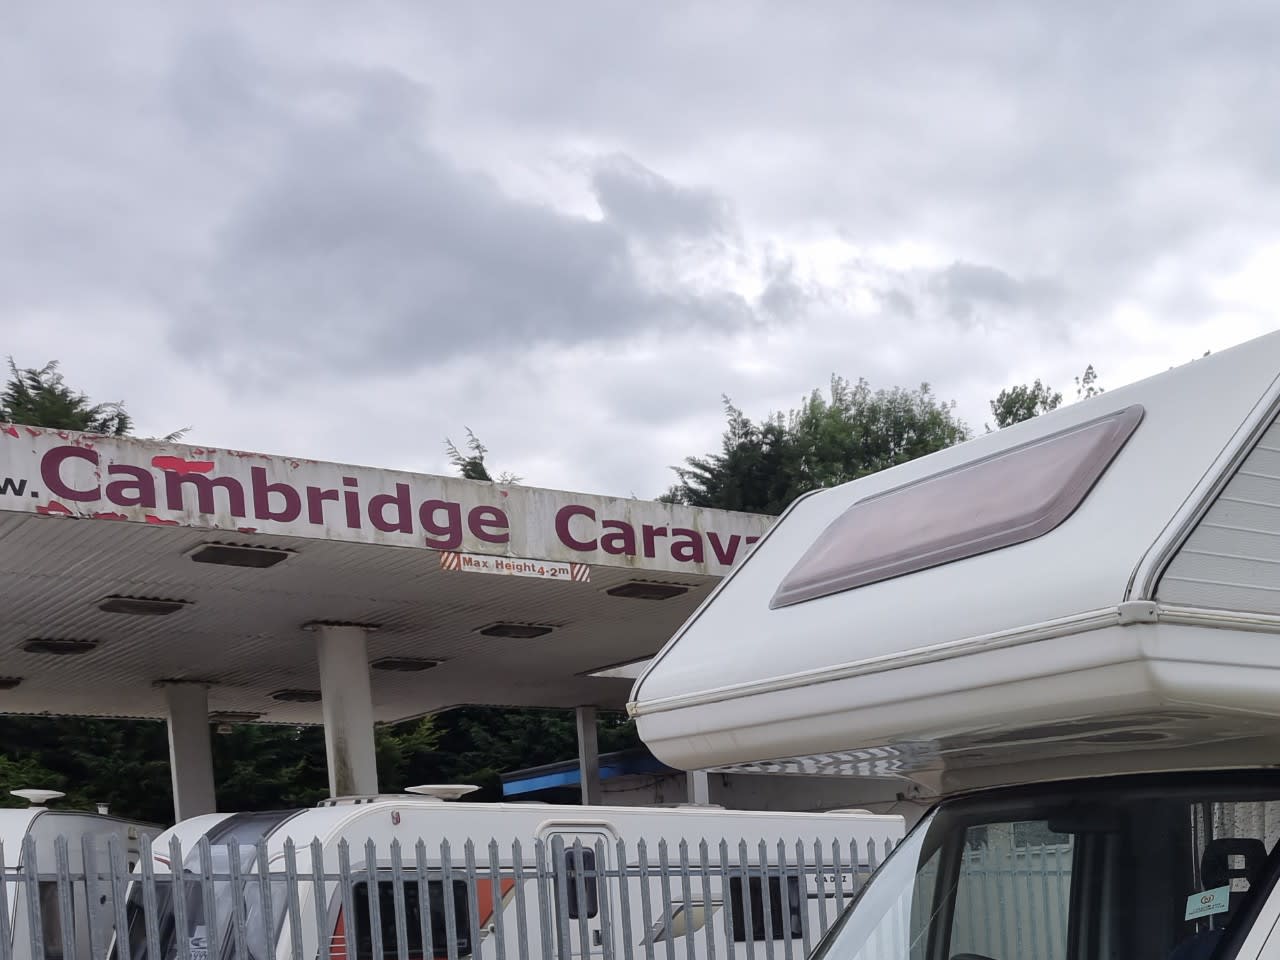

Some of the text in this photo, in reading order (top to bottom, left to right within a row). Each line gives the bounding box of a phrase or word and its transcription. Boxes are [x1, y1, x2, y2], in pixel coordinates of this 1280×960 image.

[41, 445, 510, 549] Cambridge
[554, 504, 762, 566] Carav
[462, 556, 489, 569] Max
[495, 559, 536, 573] Height
[814, 875, 847, 883] CADZ
